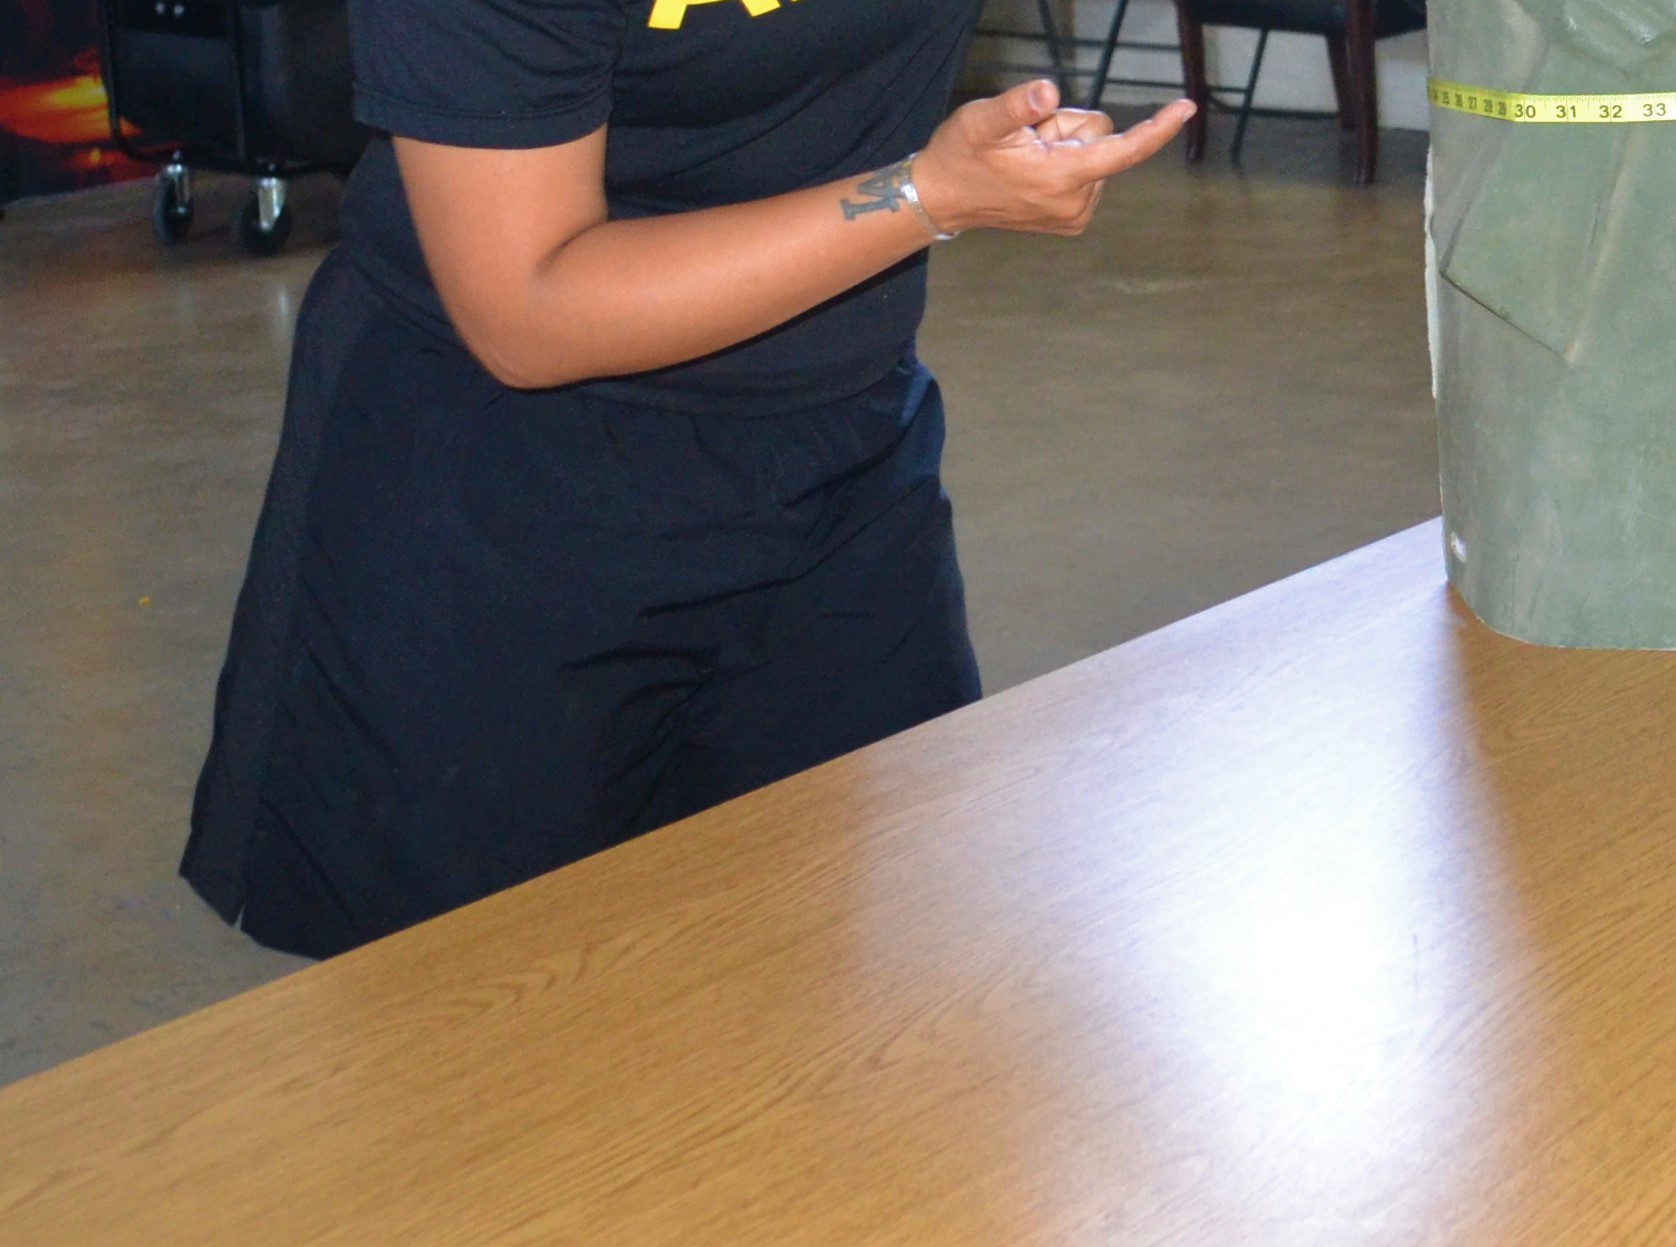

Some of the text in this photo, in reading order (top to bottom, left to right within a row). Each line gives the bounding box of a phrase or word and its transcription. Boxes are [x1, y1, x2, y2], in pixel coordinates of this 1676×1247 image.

[1514, 103, 1537, 119] 30
[1555, 105, 1577, 119] 31
[1598, 104, 1623, 119] 32
[1642, 102, 1667, 118] 33
